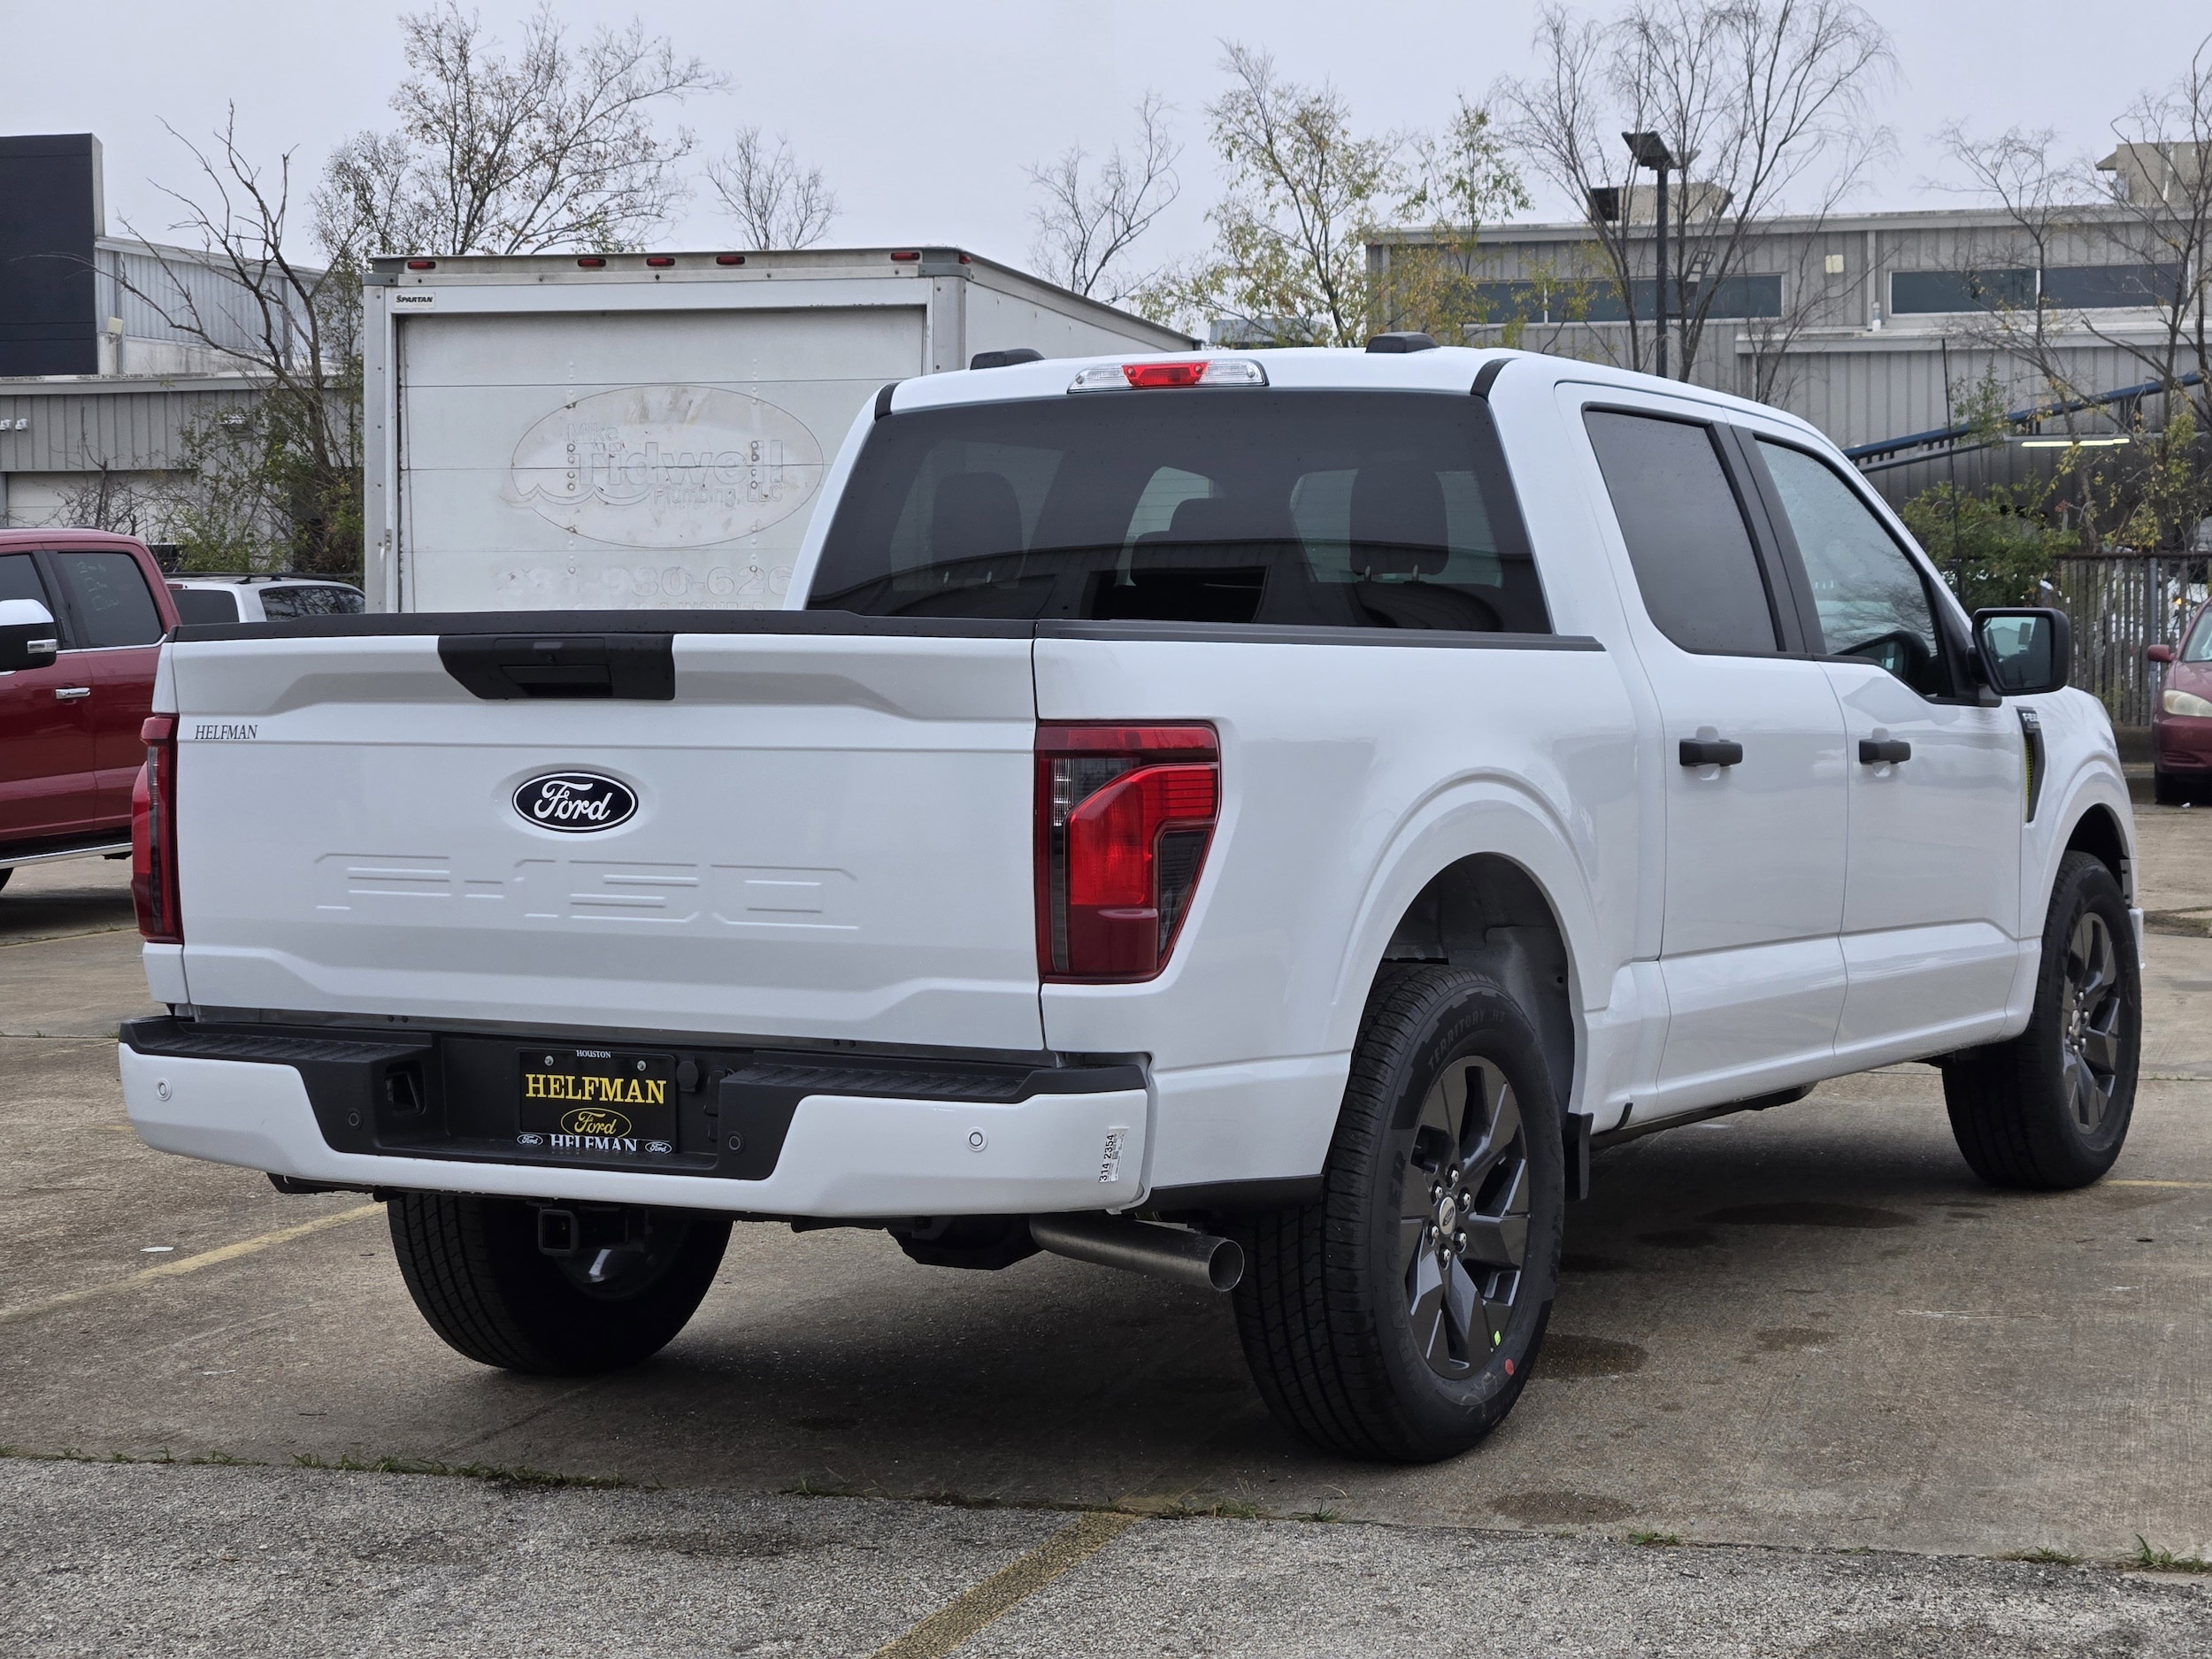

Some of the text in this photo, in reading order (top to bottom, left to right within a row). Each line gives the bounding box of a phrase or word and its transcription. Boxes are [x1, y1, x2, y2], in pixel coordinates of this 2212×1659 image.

[396, 295, 434, 303] SPARTAN
[567, 423, 619, 442] Mike
[567, 440, 784, 486] Tidwell
[747, 482, 784, 503] LLC
[194, 724, 258, 741] HELFMAN
[533, 780, 614, 821] Ford
[1427, 1008, 1507, 1072] TERRITORY HT
[576, 1049, 611, 1059] HOUSTON
[525, 1073, 667, 1104] HELFMAN
[573, 1110, 618, 1135] Ford
[520, 1134, 540, 1146] Ford
[649, 1141, 668, 1154] Ford
[1099, 1133, 1115, 1181] 314 2354
